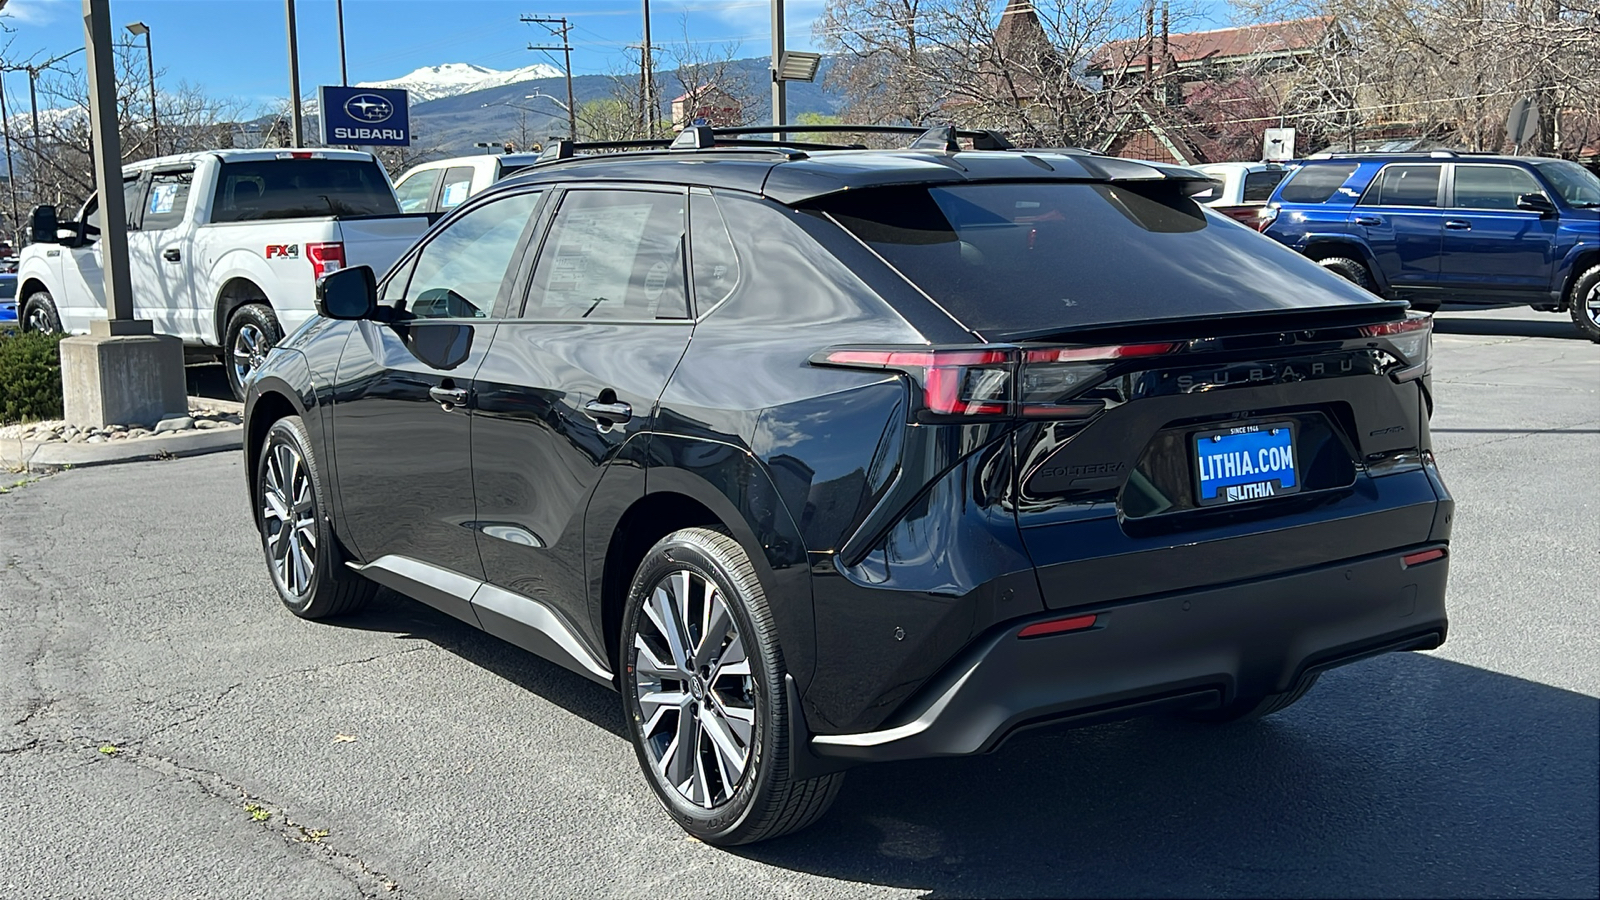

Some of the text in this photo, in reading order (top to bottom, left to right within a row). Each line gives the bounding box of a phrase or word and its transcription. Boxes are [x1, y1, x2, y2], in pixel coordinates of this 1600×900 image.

[334, 127, 404, 141] SUBARU
[266, 244, 299, 259] FX4
[1177, 358, 1353, 388] SUBARU
[1230, 425, 1259, 435] SINCE 1946
[1042, 462, 1126, 478] SOLTERRA
[1199, 445, 1294, 482] LITHIA.COM
[1238, 481, 1275, 501] LITHIA
